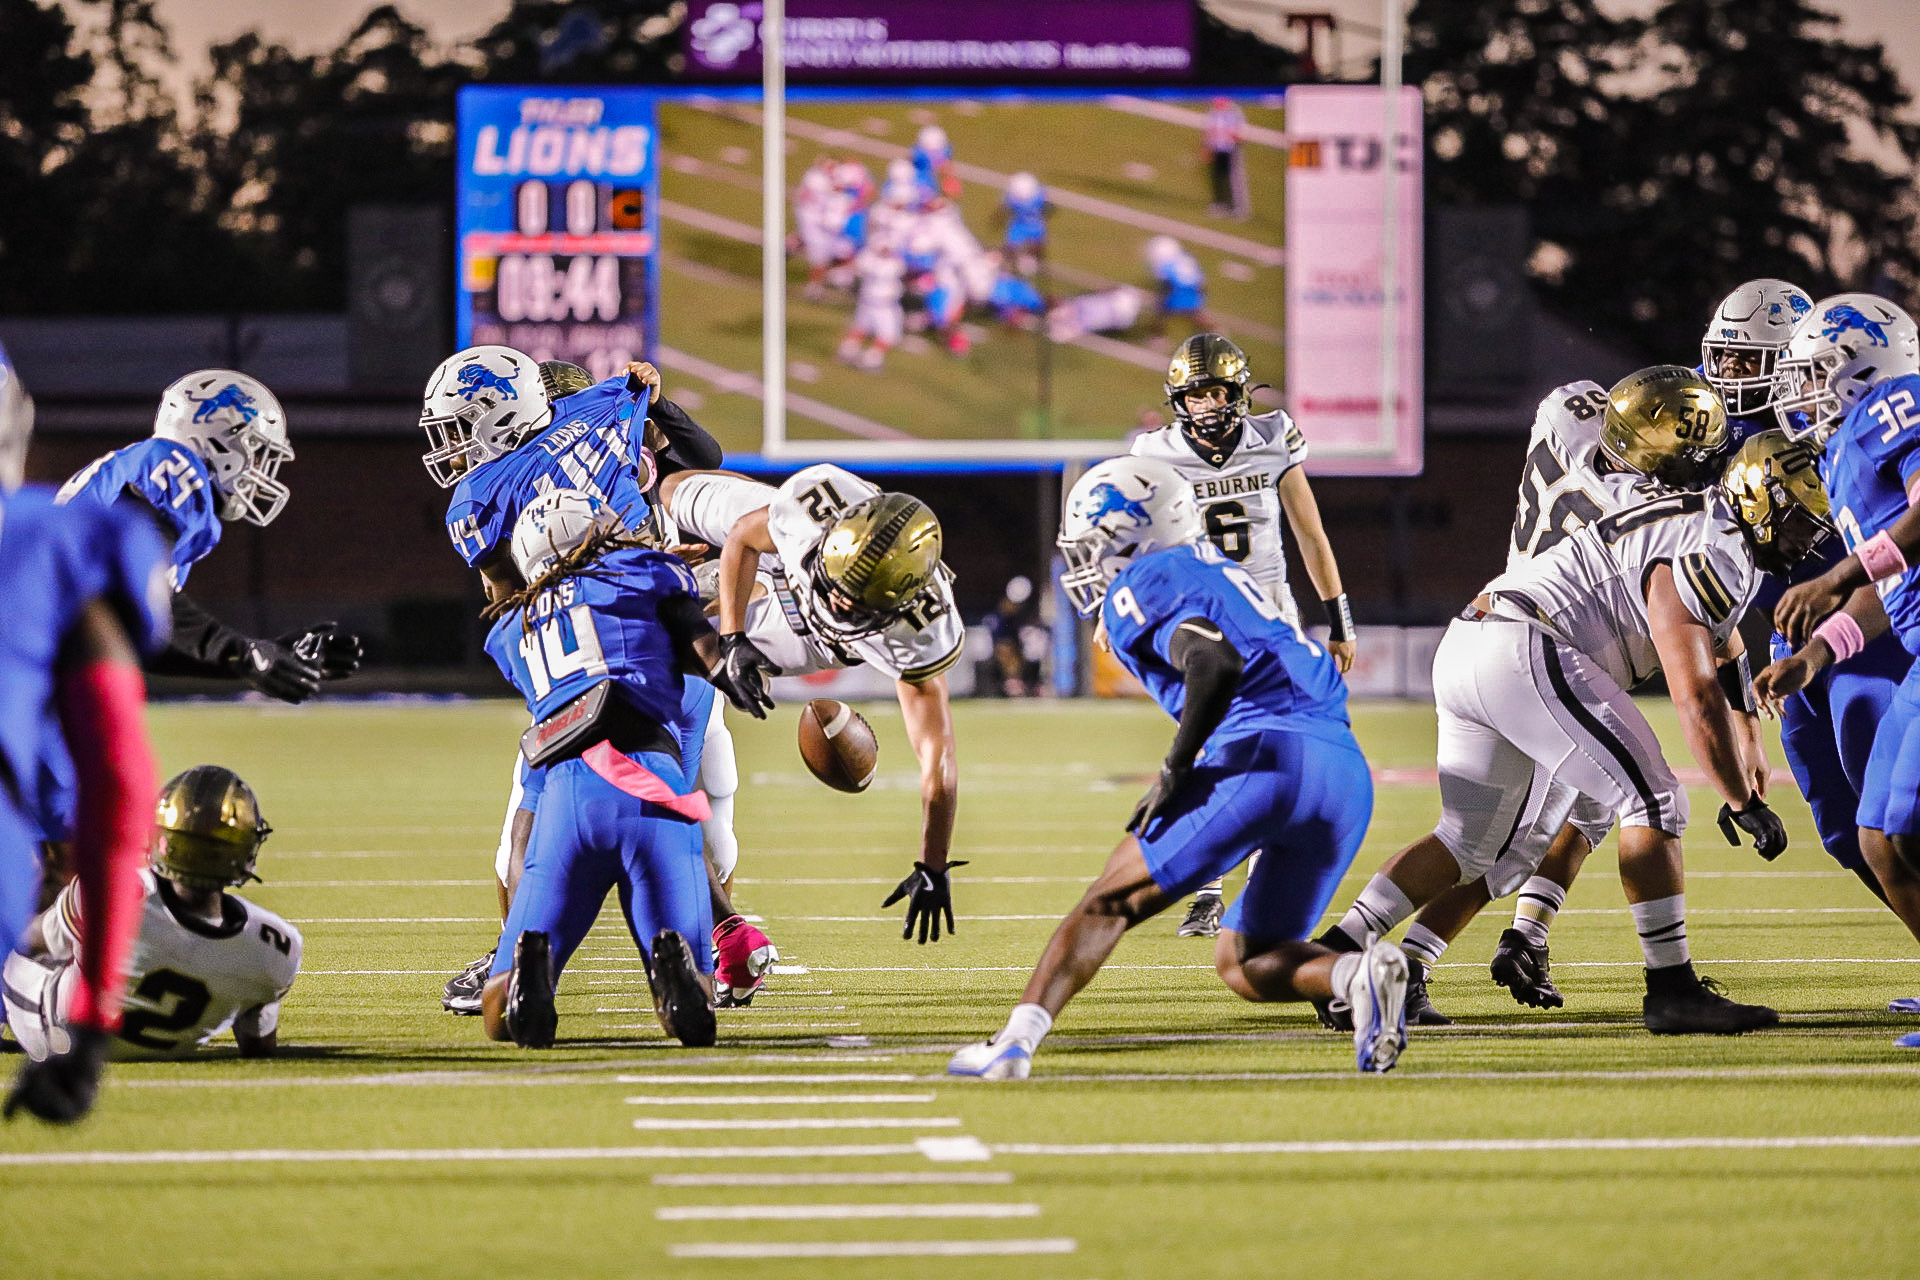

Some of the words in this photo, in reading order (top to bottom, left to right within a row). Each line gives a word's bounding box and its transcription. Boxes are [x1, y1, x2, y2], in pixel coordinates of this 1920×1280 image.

[472, 126, 649, 176] LIONS
[537, 418, 590, 456] LIONS
[1674, 405, 1710, 441] 58
[1867, 389, 1920, 444] 32
[150, 450, 204, 509] 24
[449, 514, 487, 559] 44
[1203, 500, 1253, 563] 6
[1112, 585, 1147, 627] 9
[518, 603, 609, 701] 14
[535, 700, 588, 747] DOUGLAS
[259, 923, 292, 956] 2
[122, 968, 212, 1049] 2
